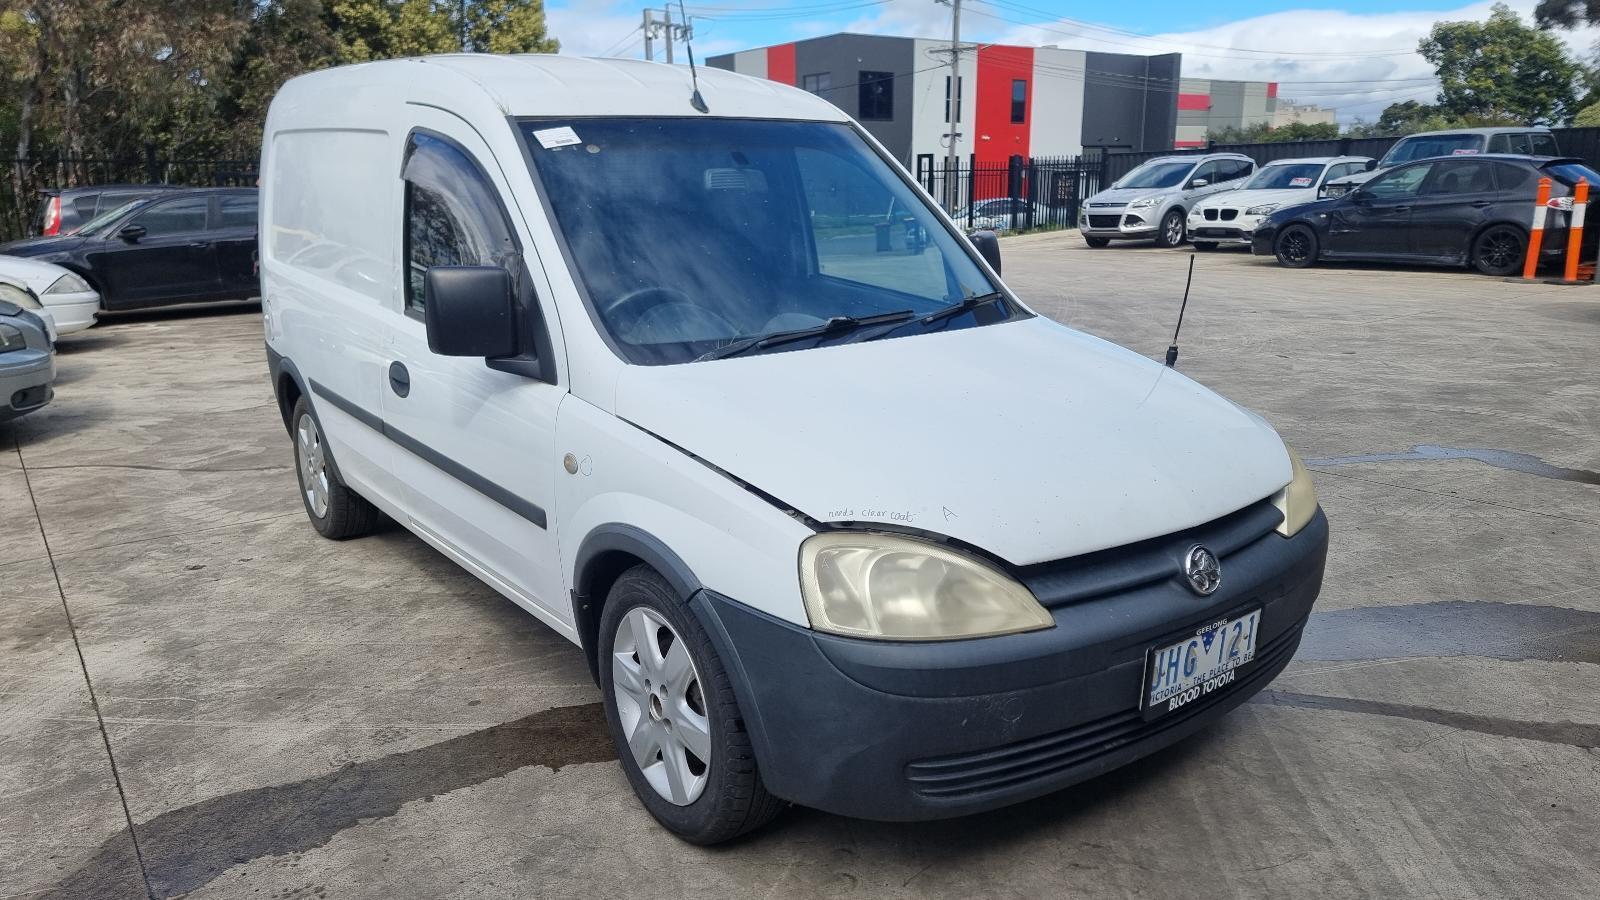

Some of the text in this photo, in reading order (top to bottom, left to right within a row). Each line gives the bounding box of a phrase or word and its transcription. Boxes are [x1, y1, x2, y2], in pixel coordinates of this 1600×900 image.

[1196, 618, 1228, 636] GEELONG
[1151, 683, 1182, 702] ICTORIA
[1193, 674, 1206, 683] THE
[1209, 663, 1230, 676] PLACE
[1232, 656, 1242, 667] TO
[1168, 669, 1235, 712] BLOOD TOYOTA
